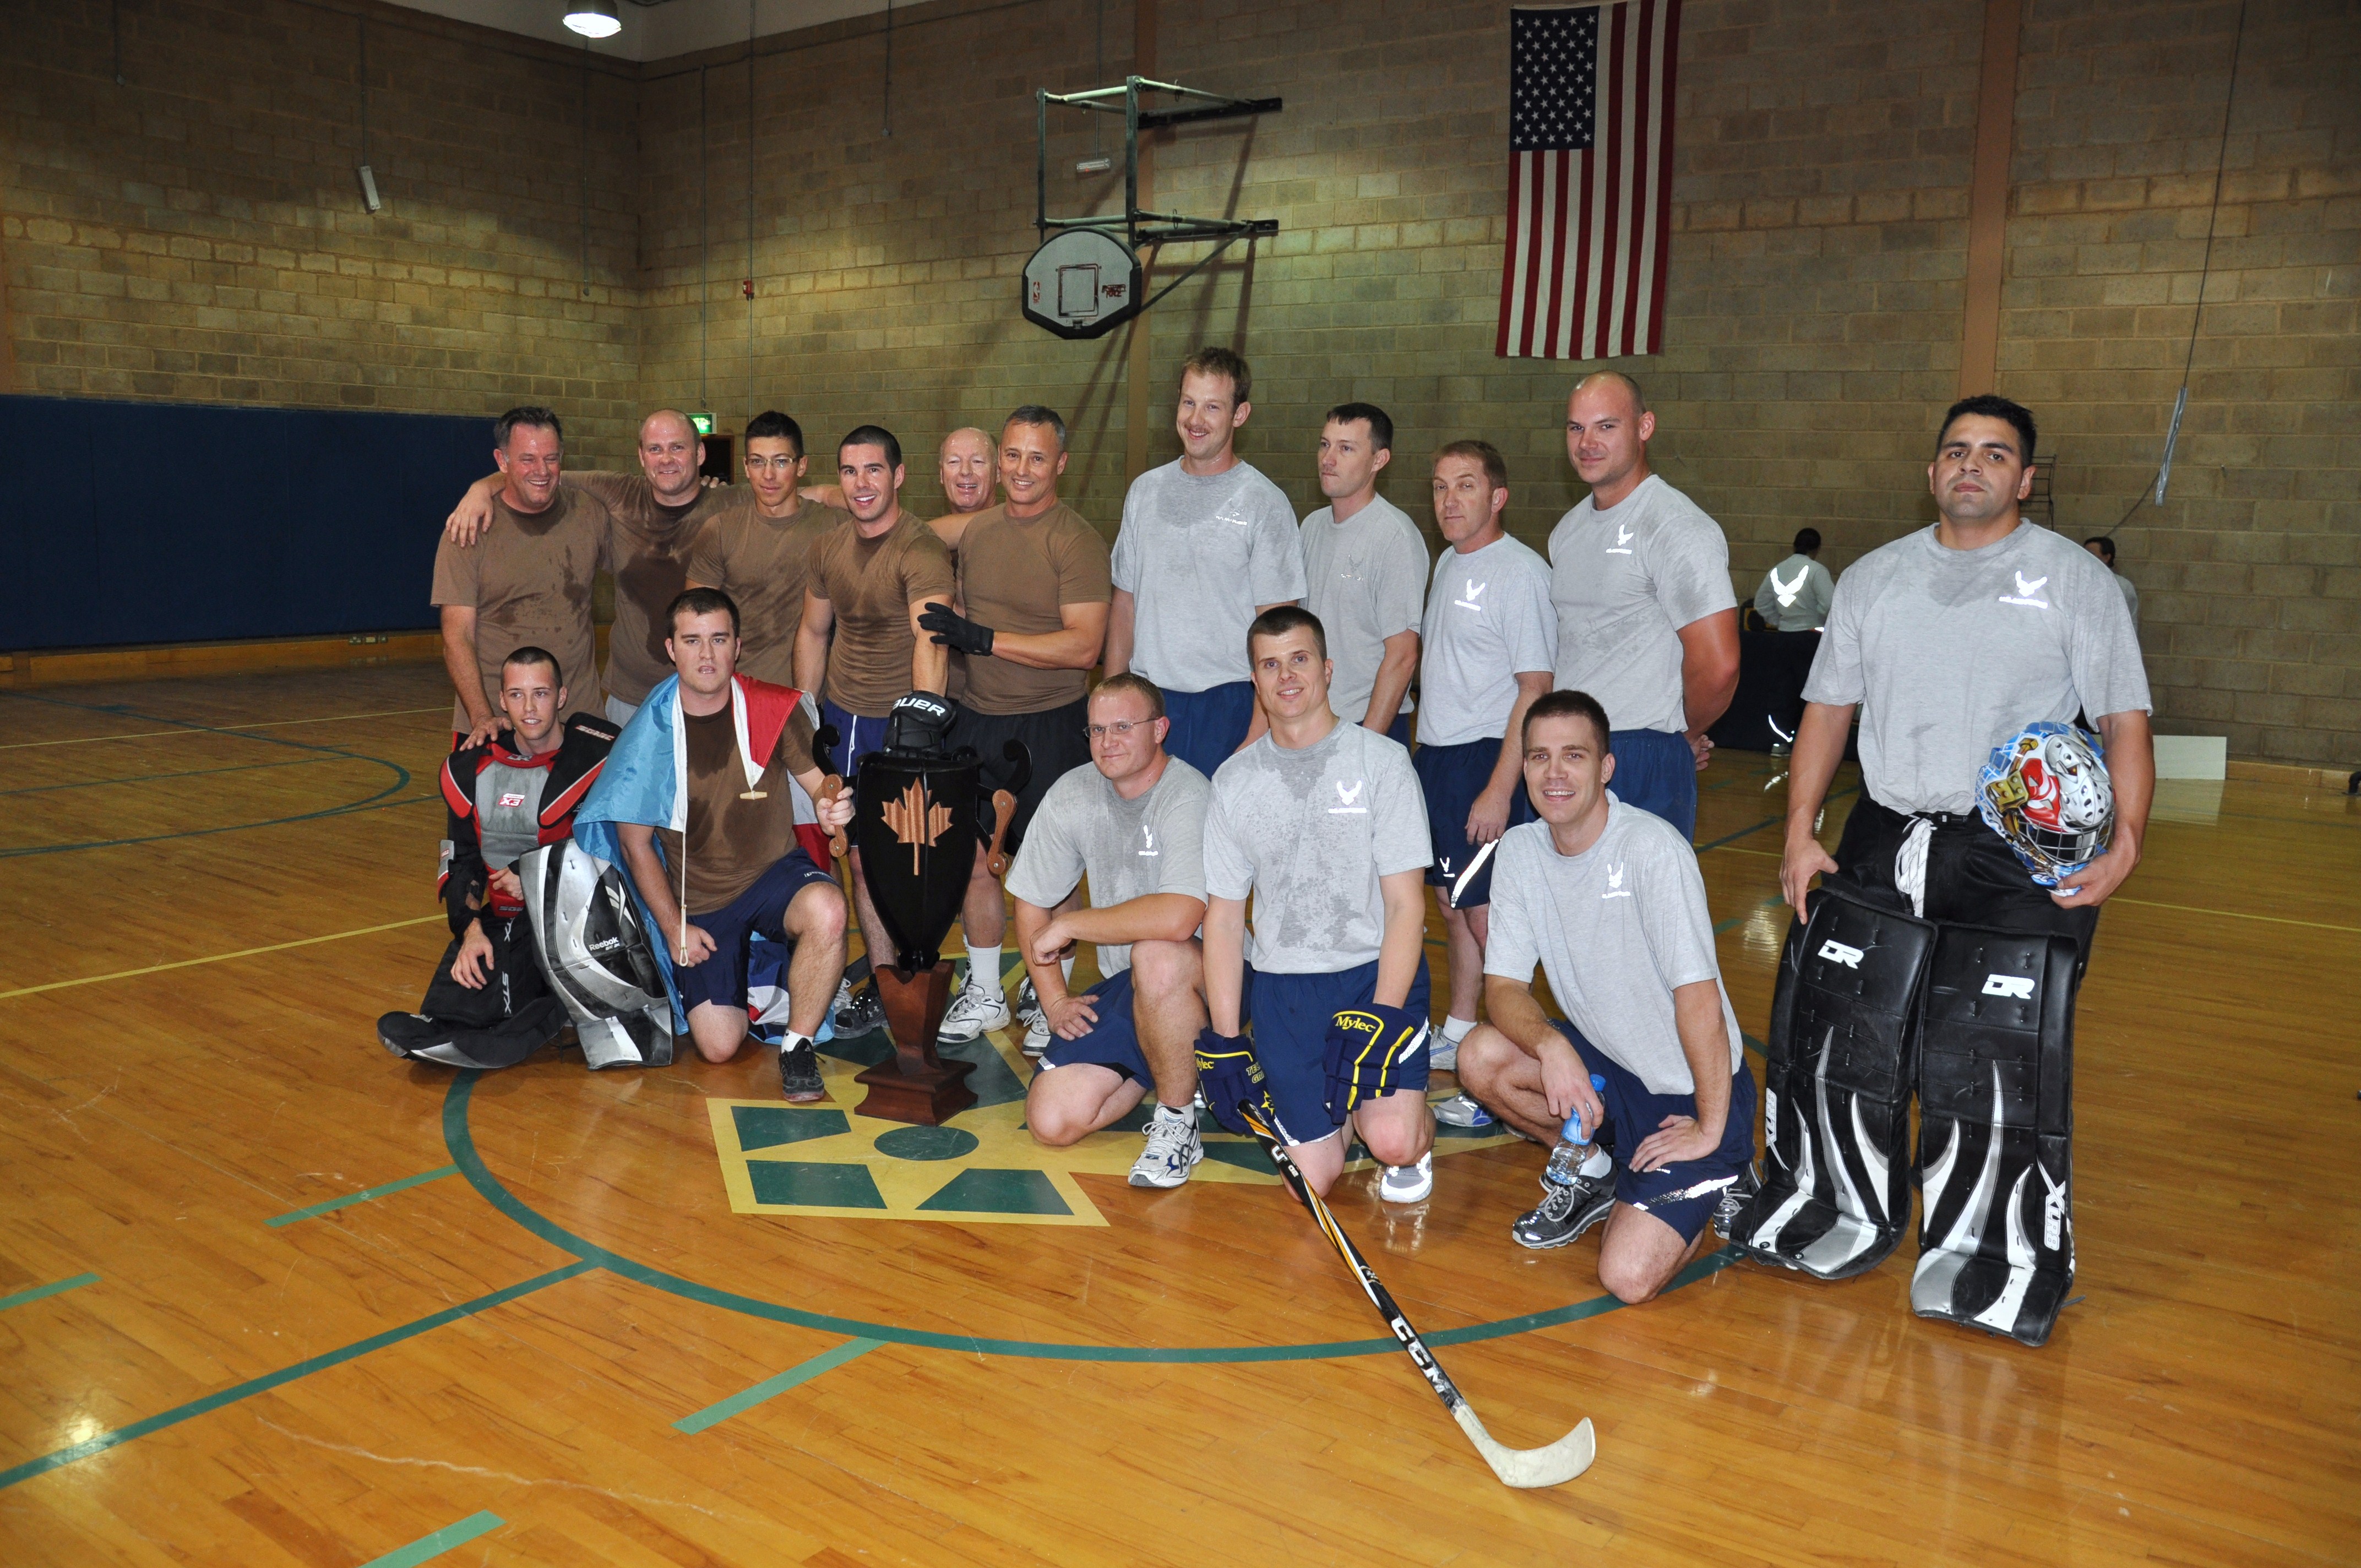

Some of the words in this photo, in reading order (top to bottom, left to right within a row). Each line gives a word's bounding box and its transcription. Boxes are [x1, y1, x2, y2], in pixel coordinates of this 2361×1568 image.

[893, 697, 946, 716] AUER
[500, 798, 521, 806] X3
[589, 937, 619, 951] Reebok
[1818, 939, 1864, 969] DR
[502, 971, 512, 1014] STX
[1982, 974, 2035, 999] DR
[1335, 1016, 1376, 1032] Mylec
[1391, 1314, 1450, 1393] CCM
